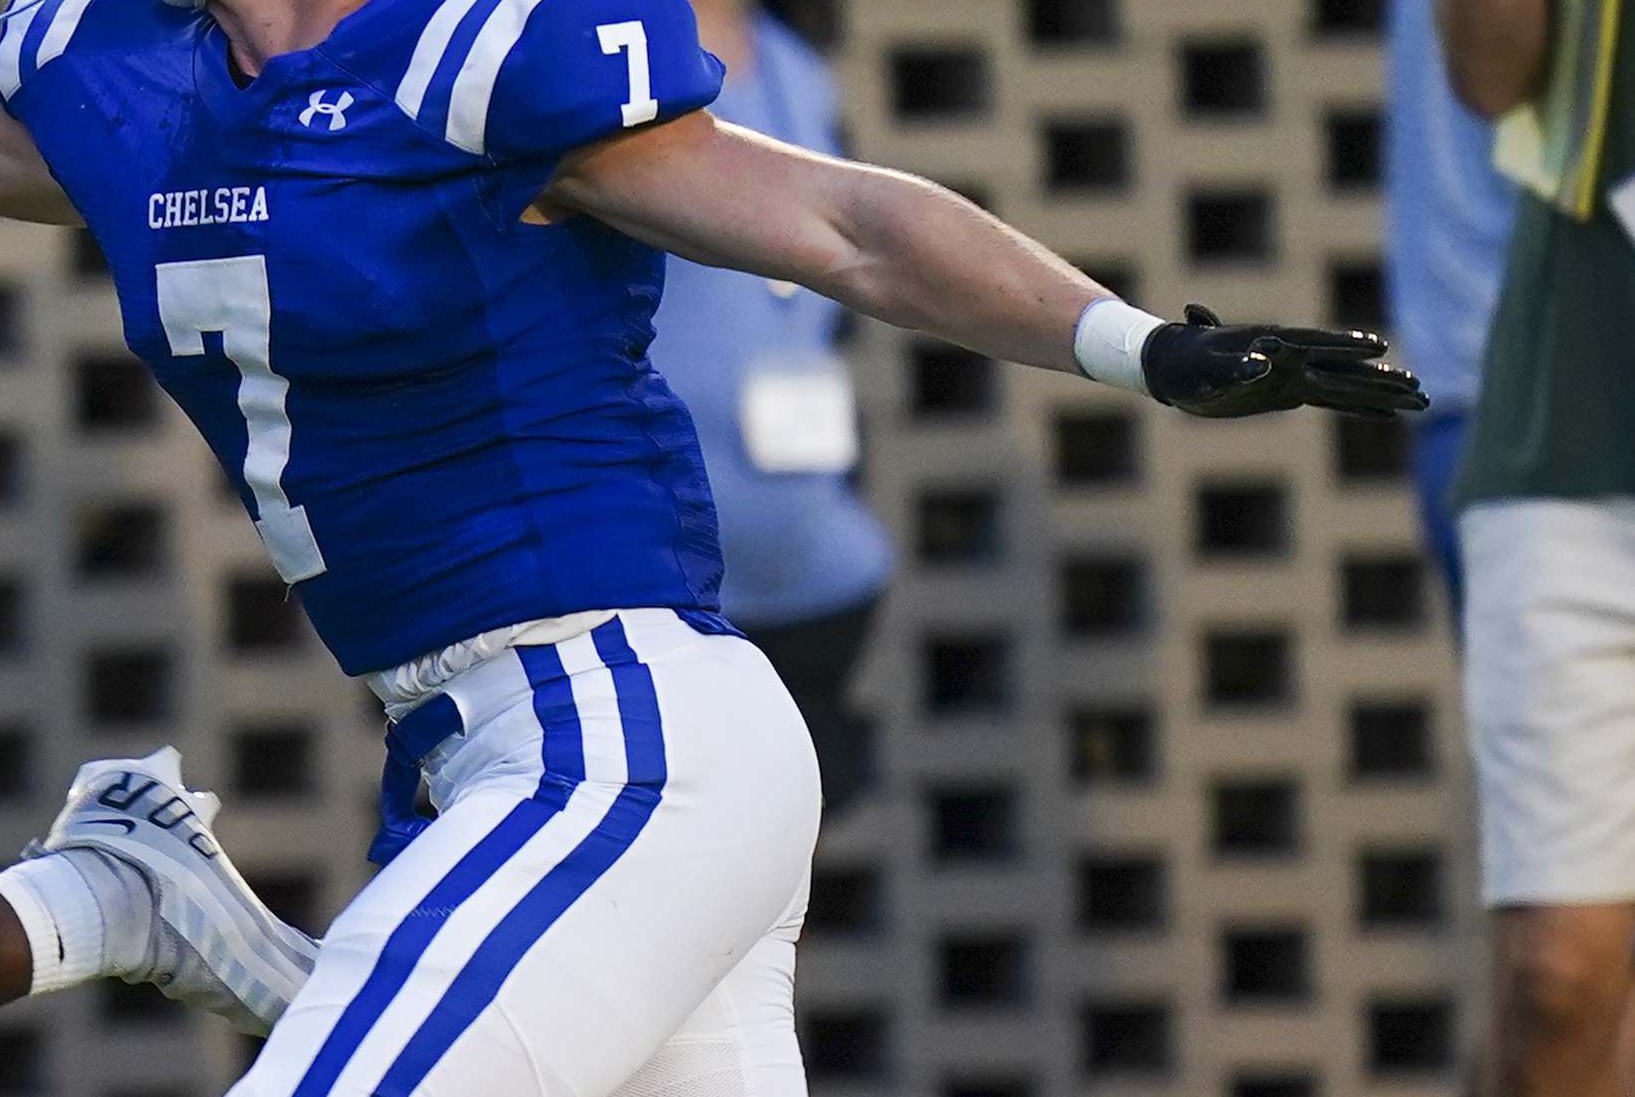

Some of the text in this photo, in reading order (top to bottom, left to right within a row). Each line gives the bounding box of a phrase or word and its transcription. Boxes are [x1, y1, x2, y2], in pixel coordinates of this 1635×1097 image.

[595, 20, 658, 128] 7
[148, 186, 269, 229] CHELSEA
[155, 254, 328, 585] 7
